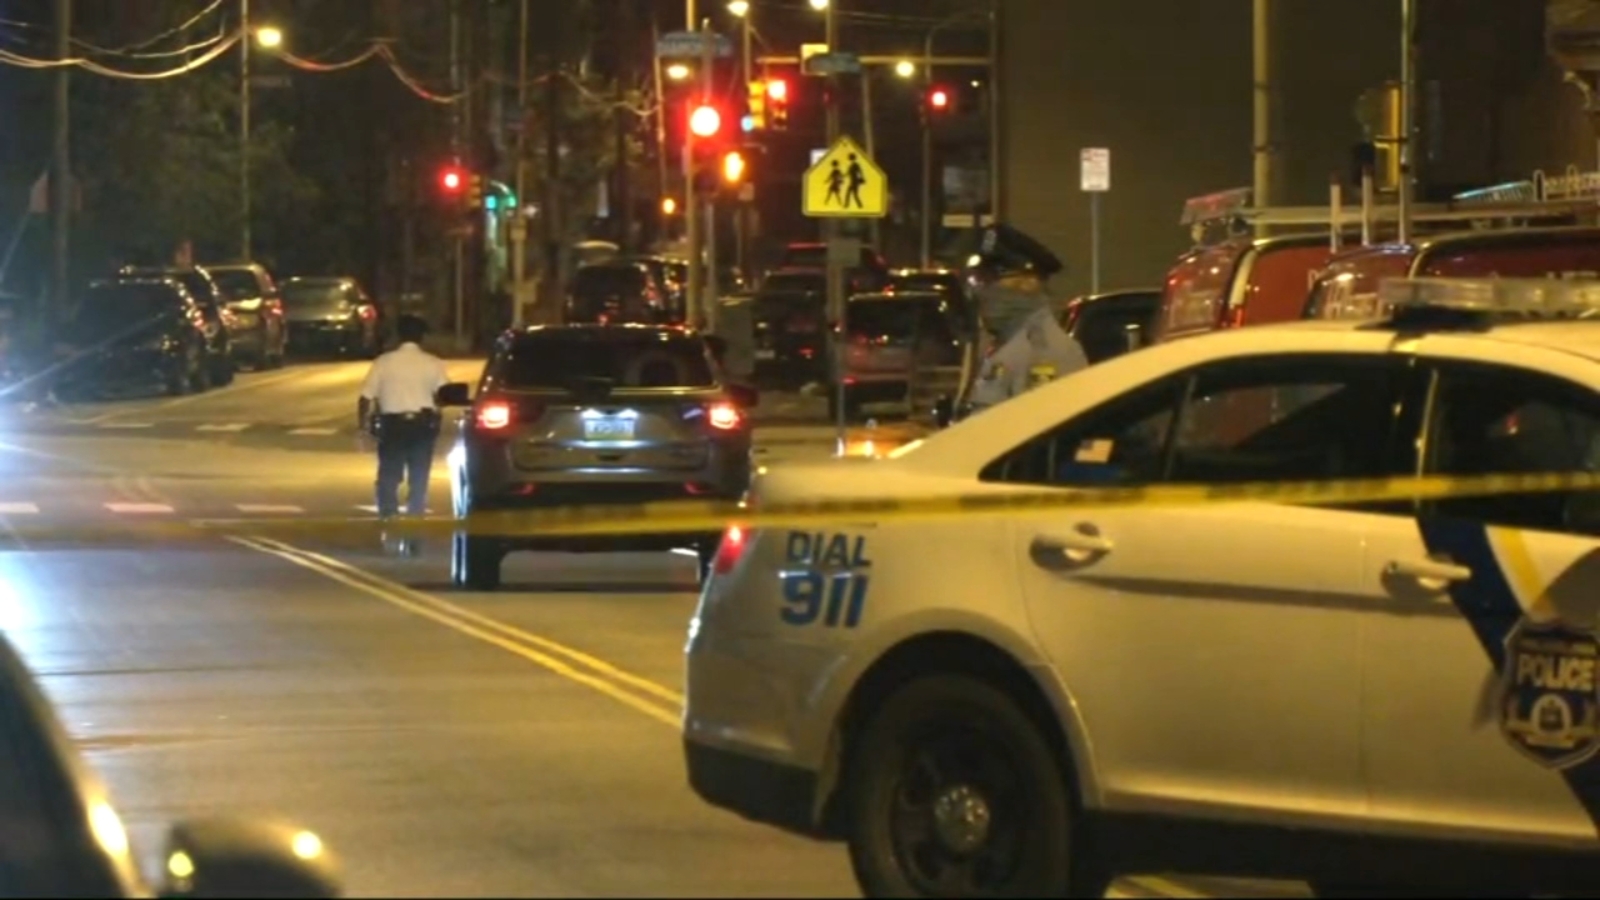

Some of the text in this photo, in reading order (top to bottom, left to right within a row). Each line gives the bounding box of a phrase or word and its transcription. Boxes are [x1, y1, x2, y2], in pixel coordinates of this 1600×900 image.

[787, 530, 872, 568] DIAL
[779, 570, 869, 628] 911
[1517, 653, 1594, 691] POLICE
